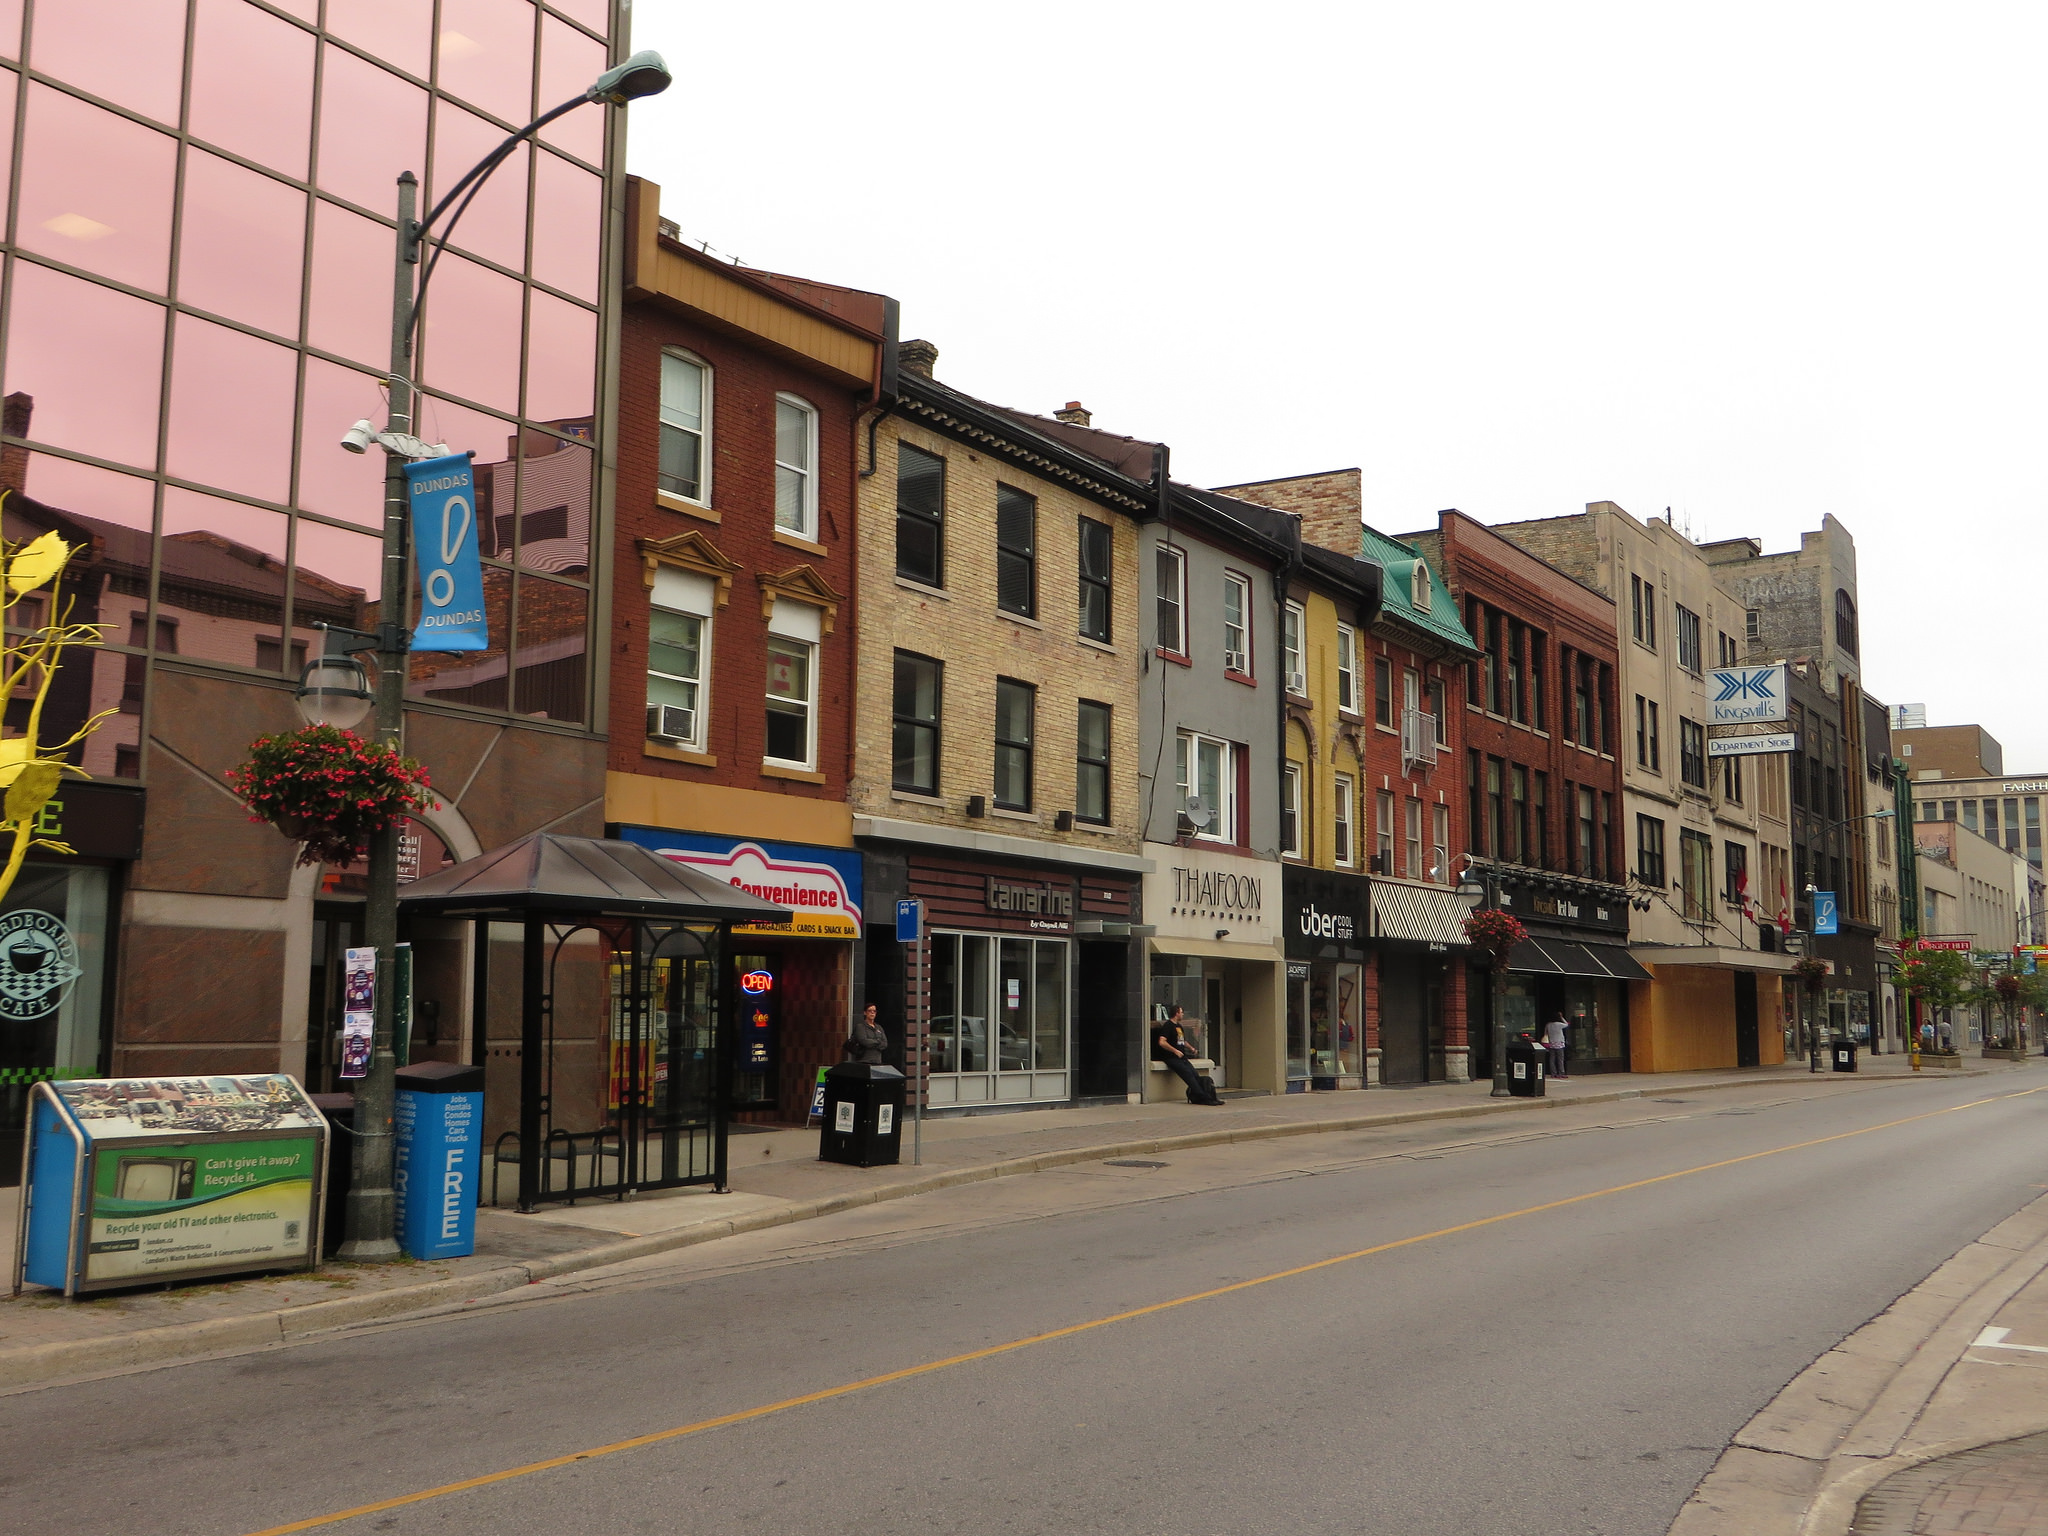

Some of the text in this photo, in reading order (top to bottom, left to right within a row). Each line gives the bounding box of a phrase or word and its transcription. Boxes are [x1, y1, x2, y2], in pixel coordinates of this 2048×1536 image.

[414, 473, 469, 495] DUNDAS
[424, 609, 482, 628] DUNDAS
[987, 876, 1073, 915] tamarine
[1172, 867, 1261, 910] THAIFOON
[1171, 907, 1261, 922] RESTAURANT
[1301, 904, 1353, 938] über COOL
[797, 924, 816, 934] CARDS
[824, 926, 842, 934] SNACK
[844, 927, 855, 935] BAR
[1337, 928, 1353, 939] STUFF
[742, 974, 772, 990] OPEN
[245, 1087, 292, 1103] Food
[444, 1103, 472, 1111] Rentals
[444, 1111, 472, 1119] Condos
[444, 1119, 470, 1127] Homes
[205, 1154, 300, 1170] Can't give it away?
[204, 1172, 256, 1186] Recycle it.
[442, 1149, 465, 1238] FREE
[106, 1210, 279, 1235] Recycle your old TV and other electronics.
